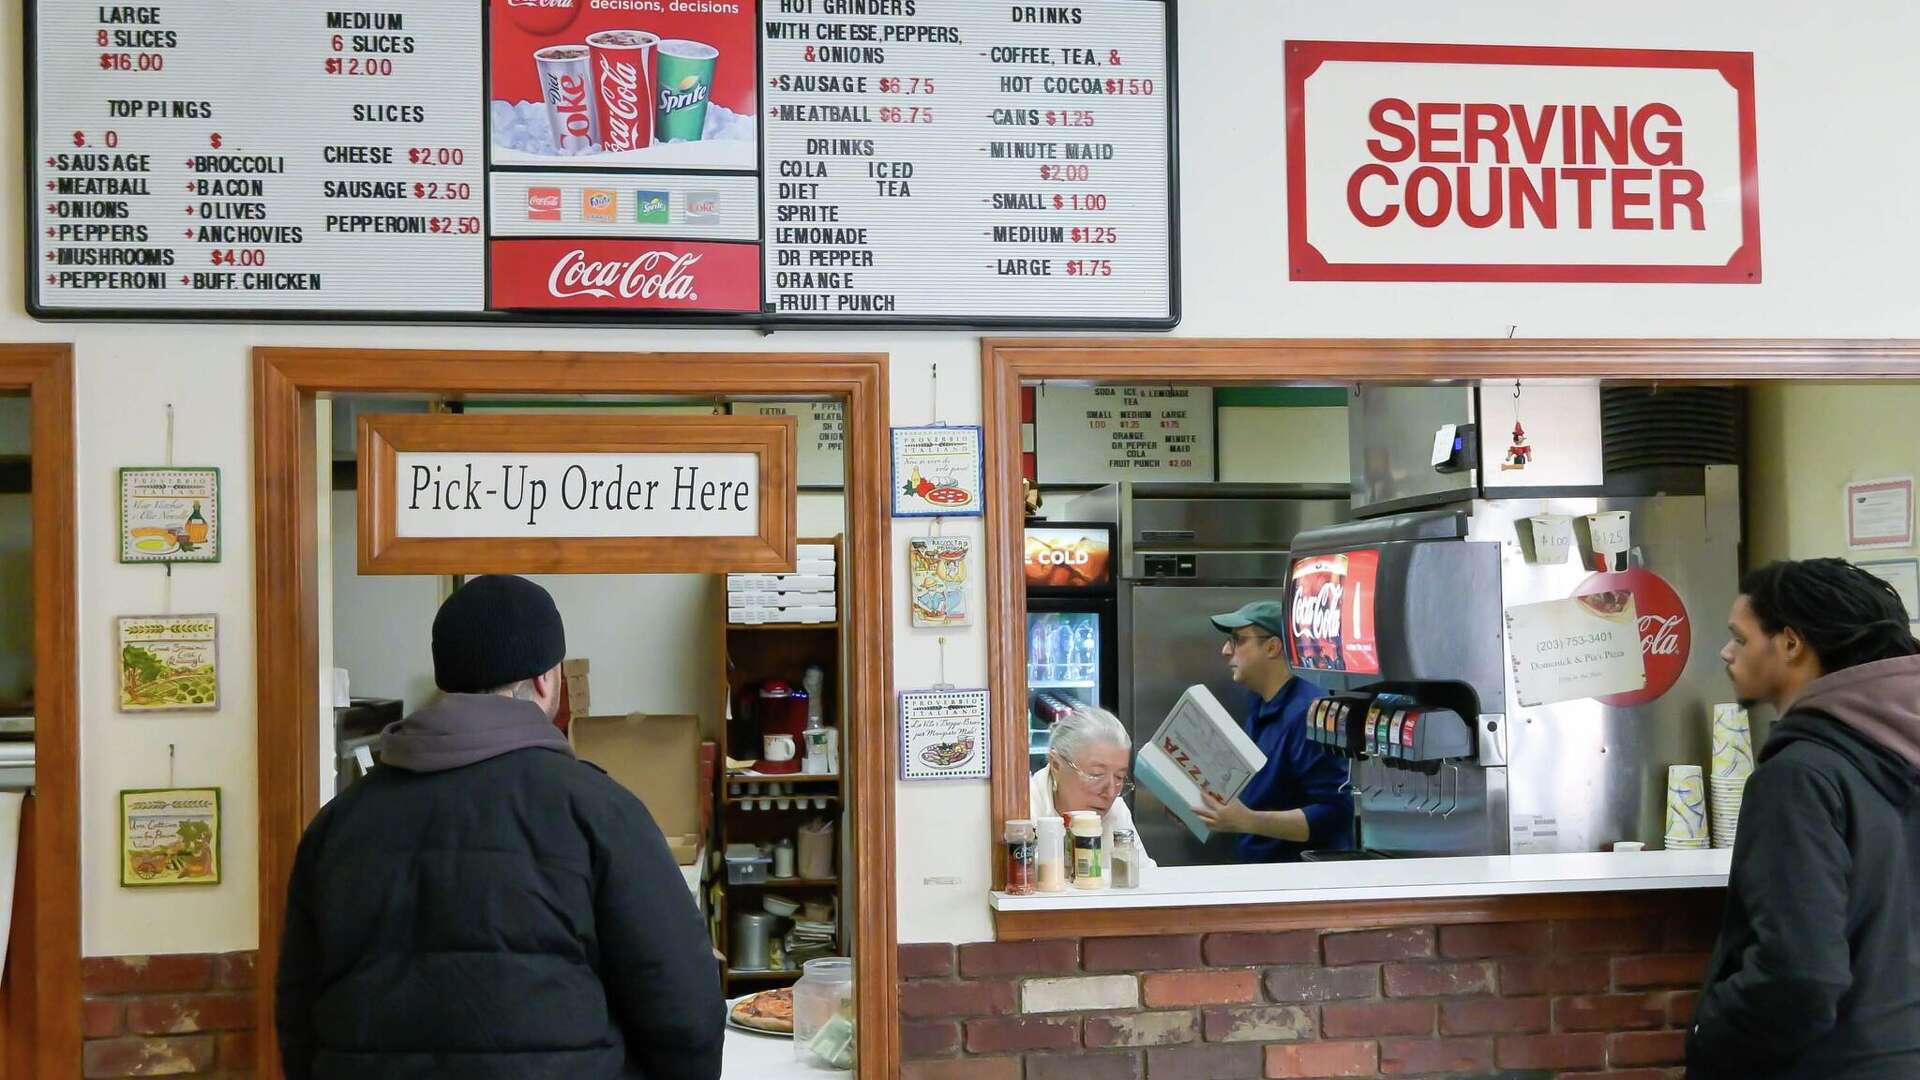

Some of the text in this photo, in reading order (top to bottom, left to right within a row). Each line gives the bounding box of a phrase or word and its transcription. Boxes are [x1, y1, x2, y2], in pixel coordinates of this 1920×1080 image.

[99, 7, 161, 24] LARGE
[590, 0, 739, 14] decisions, decisions
[781, 0, 916, 16] HOT GRINDERS
[1012, 6, 1082, 24] DRINKS
[327, 12, 402, 30] MEDIUM
[97, 30, 177, 48] 8 SLICES
[766, 22, 809, 39] WITH
[332, 35, 414, 53] 6 SLICES
[100, 53, 163, 71] $16.00
[1109, 49, 1121, 65] &
[325, 58, 392, 75] $12.00
[547, 73, 561, 104] Diet
[780, 75, 935, 95] SAUSAGE $6.75
[1000, 76, 1033, 92] HOT
[1044, 77, 1103, 94] COCOA
[659, 82, 707, 114] Sprite
[108, 100, 212, 118] TOPPINGS
[353, 105, 424, 123] SLICES
[780, 105, 933, 124] MEATBALL $6.75
[992, 109, 1040, 126] CANS
[1366, 98, 1683, 167] SERVING
[806, 138, 875, 156] DRINKS
[990, 142, 1114, 160] MINUTE MAID
[58, 154, 150, 172] SAUSAGE
[195, 156, 284, 173] BROCCOLI
[324, 147, 464, 166] CHEESE $2.00
[780, 161, 827, 178] COLA
[868, 162, 914, 179] ICED
[1040, 165, 1089, 182] $2.00
[58, 178, 150, 195] MEATBALL
[198, 180, 263, 196] BACON
[324, 182, 470, 200] SAUSAGE $2.50
[779, 184, 819, 200] DIET
[877, 181, 911, 198] TEA
[993, 193, 1047, 210] SMALL
[1346, 163, 1706, 231] COUNTER
[58, 201, 129, 219] ONIONS
[200, 203, 266, 220] OLIVES
[777, 205, 839, 222] SPRITE
[59, 225, 149, 242] PEPPERS
[326, 216, 480, 235] PEPPERONI $2.50
[198, 226, 302, 244] ANCHOVIES
[776, 228, 868, 245] LEMONADE
[993, 226, 1064, 243] MEDIUM
[58, 248, 174, 266] MUSHROOMS
[211, 250, 265, 267] $4.00
[778, 251, 874, 268] DR PEPPER
[548, 250, 704, 300] Coca-Cola
[998, 259, 1112, 277] LARGE $1.75
[59, 272, 166, 289] PEPPERONI
[243, 273, 321, 290] CHICKEN
[776, 272, 854, 289] ORANGE
[780, 295, 896, 312] FRUIT PUNCH
[408, 464, 749, 525] Pick-Up Order Here
[1039, 551, 1088, 565] COLD
[1537, 632, 1613, 653] (203) 753-3401
